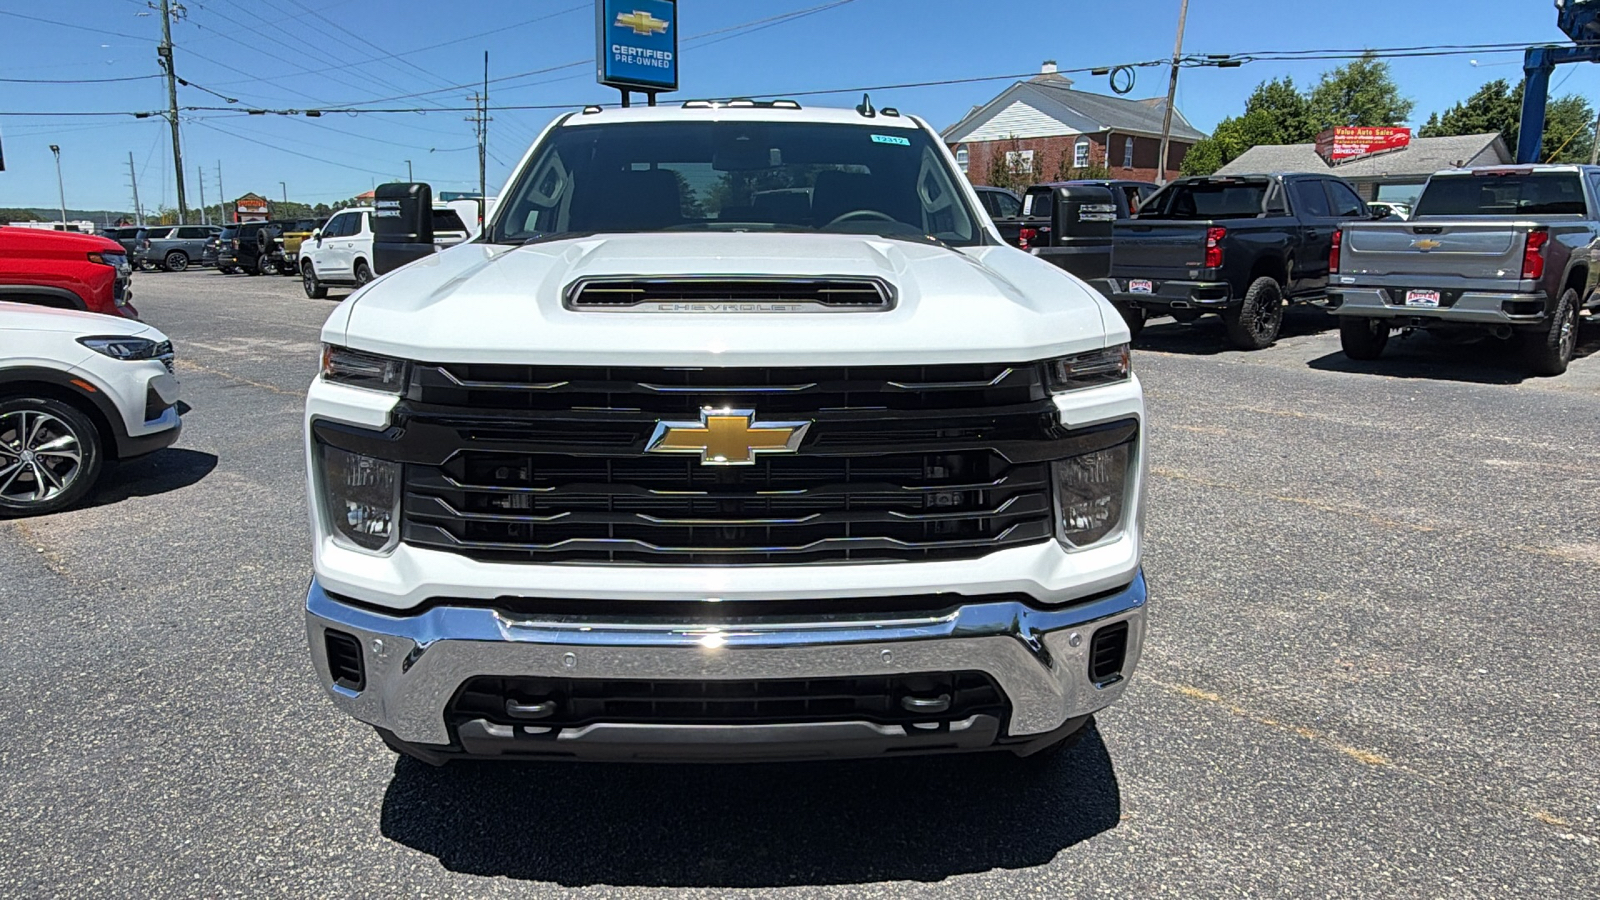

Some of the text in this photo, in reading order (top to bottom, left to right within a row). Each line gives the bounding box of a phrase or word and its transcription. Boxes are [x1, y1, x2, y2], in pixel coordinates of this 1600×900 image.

[612, 44, 672, 60] CERTIFIED
[615, 53, 669, 68] PRE-OWNED
[1336, 128, 1354, 136] Value
[1375, 128, 1394, 136] Sales
